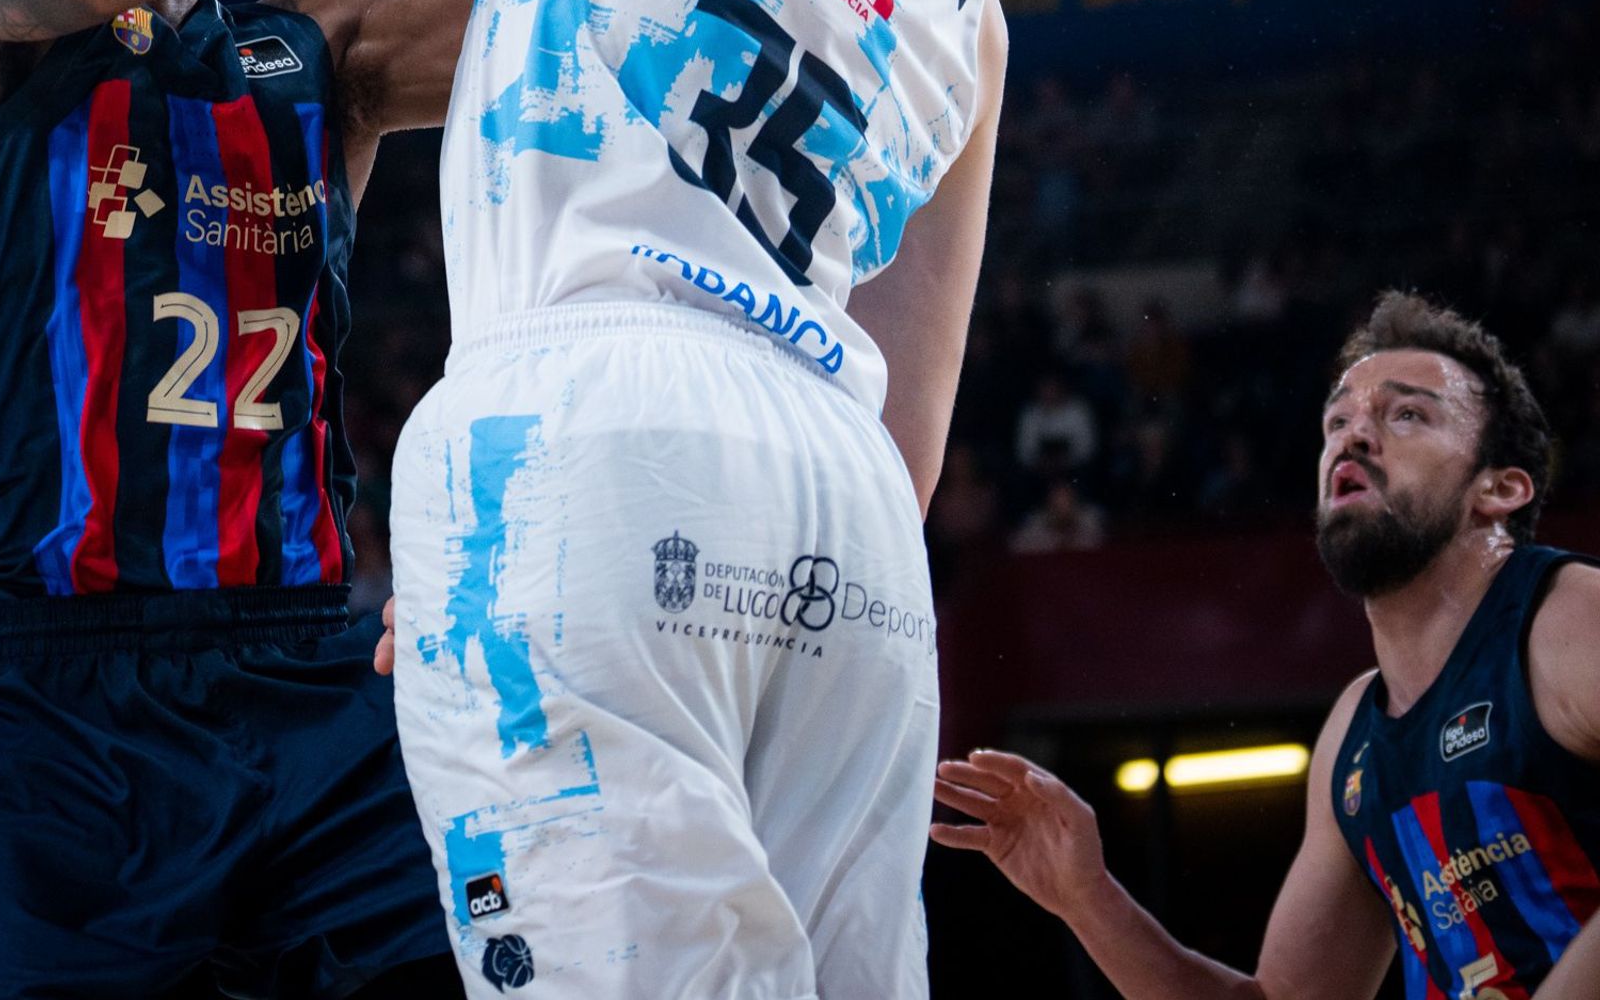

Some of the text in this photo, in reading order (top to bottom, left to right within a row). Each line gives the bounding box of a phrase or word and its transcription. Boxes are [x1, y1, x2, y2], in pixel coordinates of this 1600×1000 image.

[242, 57, 296, 74] ndesa
[184, 208, 315, 256] Sanitària
[146, 291, 301, 431] 22
[703, 582, 723, 600] DE
[470, 889, 502, 916] acb
